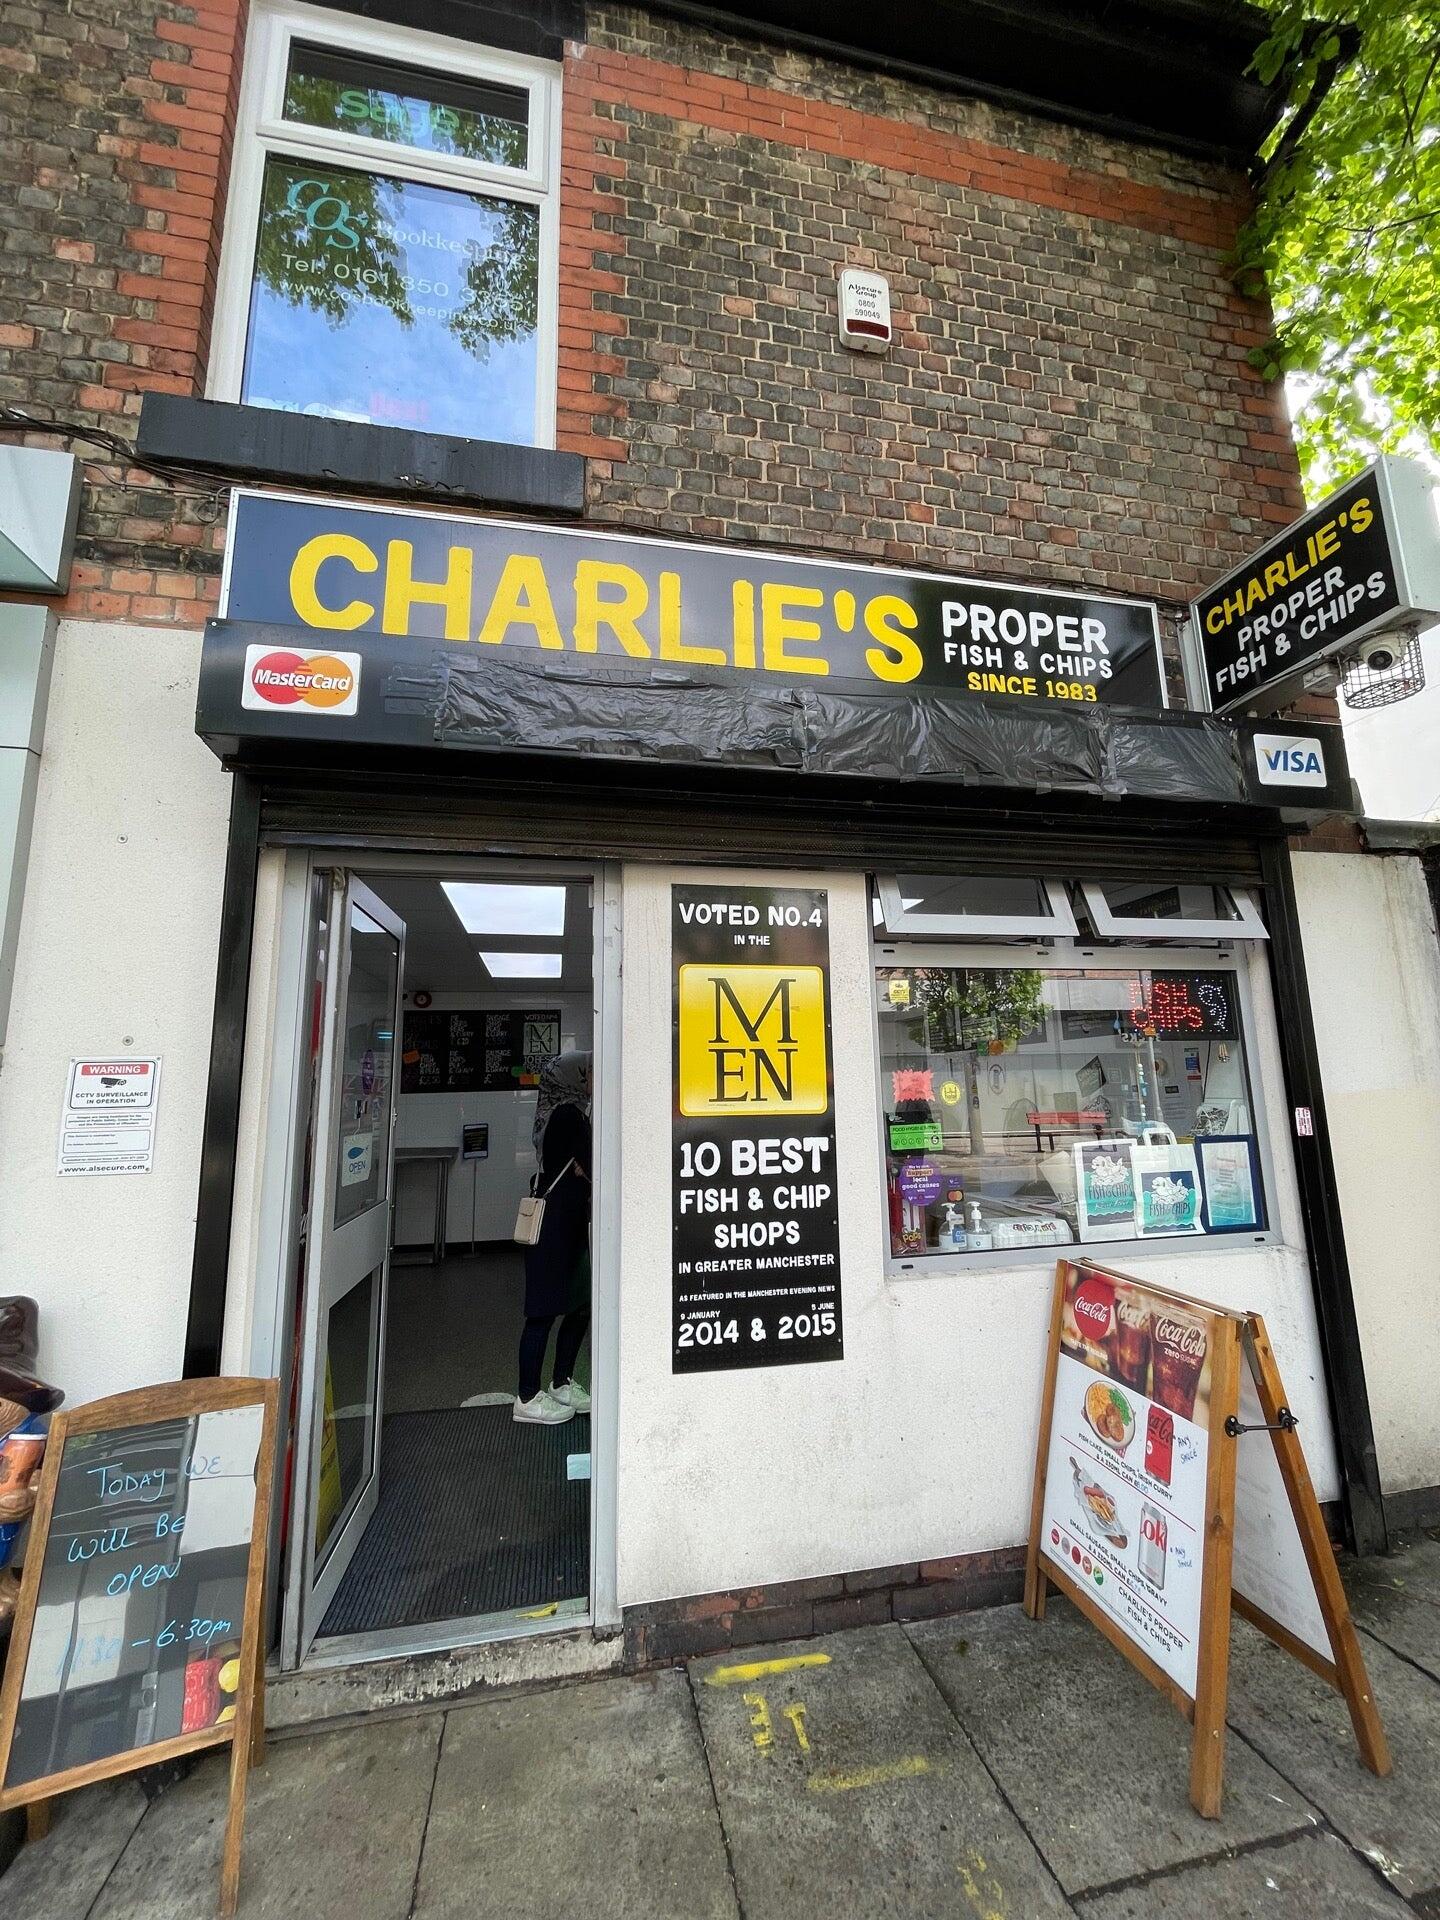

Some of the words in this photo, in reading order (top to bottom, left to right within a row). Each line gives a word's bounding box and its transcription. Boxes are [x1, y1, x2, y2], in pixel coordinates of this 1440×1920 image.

[334, 264, 389, 289] 0161
[400, 275, 449, 297] 850
[1205, 497, 1374, 635] CHARLIE'S
[289, 532, 925, 683] CHARLIE'S
[1236, 565, 1345, 651] PROPER
[942, 600, 1110, 655] PROPER
[1215, 650, 1267, 693] FISH
[1274, 632, 1292, 656] &
[1299, 570, 1387, 640] CHIPS
[943, 642, 1003, 669] FISH
[1013, 650, 1029, 671] &
[1039, 653, 1114, 679] CHIPS
[251, 667, 351, 693] MasterCard
[967, 672, 1039, 696] SINCE
[1045, 680, 1098, 702] 1983
[1260, 749, 1322, 774] VISA
[678, 903, 760, 926] VOTED
[768, 906, 823, 928] NO.4
[734, 934, 745, 945] IN
[748, 934, 771, 946] THE
[1129, 982, 1187, 1005] FISH
[1130, 1005, 1203, 1028] CHIPS
[89, 1066, 141, 1074] WARNING
[64, 1164, 145, 1173] www.alsecure.com
[680, 1142, 721, 1177] 10
[731, 1137, 830, 1176] BEST
[680, 1187, 738, 1214] FISH
[748, 1187, 764, 1211] &
[773, 1183, 831, 1210] CHIP
[714, 1220, 800, 1248] SHOPS
[678, 1261, 691, 1274] IN
[695, 1258, 752, 1273] GREATER
[756, 1253, 835, 1269] MANCHESTER
[679, 1295, 688, 1303] AS
[690, 1292, 724, 1302] FEATURED
[725, 1291, 733, 1299] IN
[734, 1290, 747, 1299] THE
[748, 1288, 788, 1298] MANCHESTER
[790, 1286, 817, 1296] EVENING
[818, 1284, 836, 1293] NEWS
[818, 1302, 835, 1311] JUNE
[678, 1319, 740, 1347] 2014
[750, 1317, 767, 1342] &
[778, 1312, 837, 1340] 2015
[680, 1313, 686, 1321] 9
[687, 1310, 721, 1320] JANUARY
[1078, 1433, 1089, 1443] FISH
[1104, 1449, 1120, 1465] SMALL
[1153, 1483, 1173, 1501] CURRY
[1121, 1470, 1133, 1484] CAN
[106, 1556, 183, 1597] OPEN
[1069, 1519, 1085, 1537] SMALL
[1110, 1554, 1127, 1573] SMALL
[1147, 1586, 1168, 1607] GRAVY
[1114, 1566, 1126, 1580] CAN
[1118, 1586, 1153, 1622] CHARLIE'S
[1153, 1618, 1183, 1651] PROPER
[1127, 1607, 1143, 1625] FISH
[1149, 1628, 1171, 1652] CHIPS
